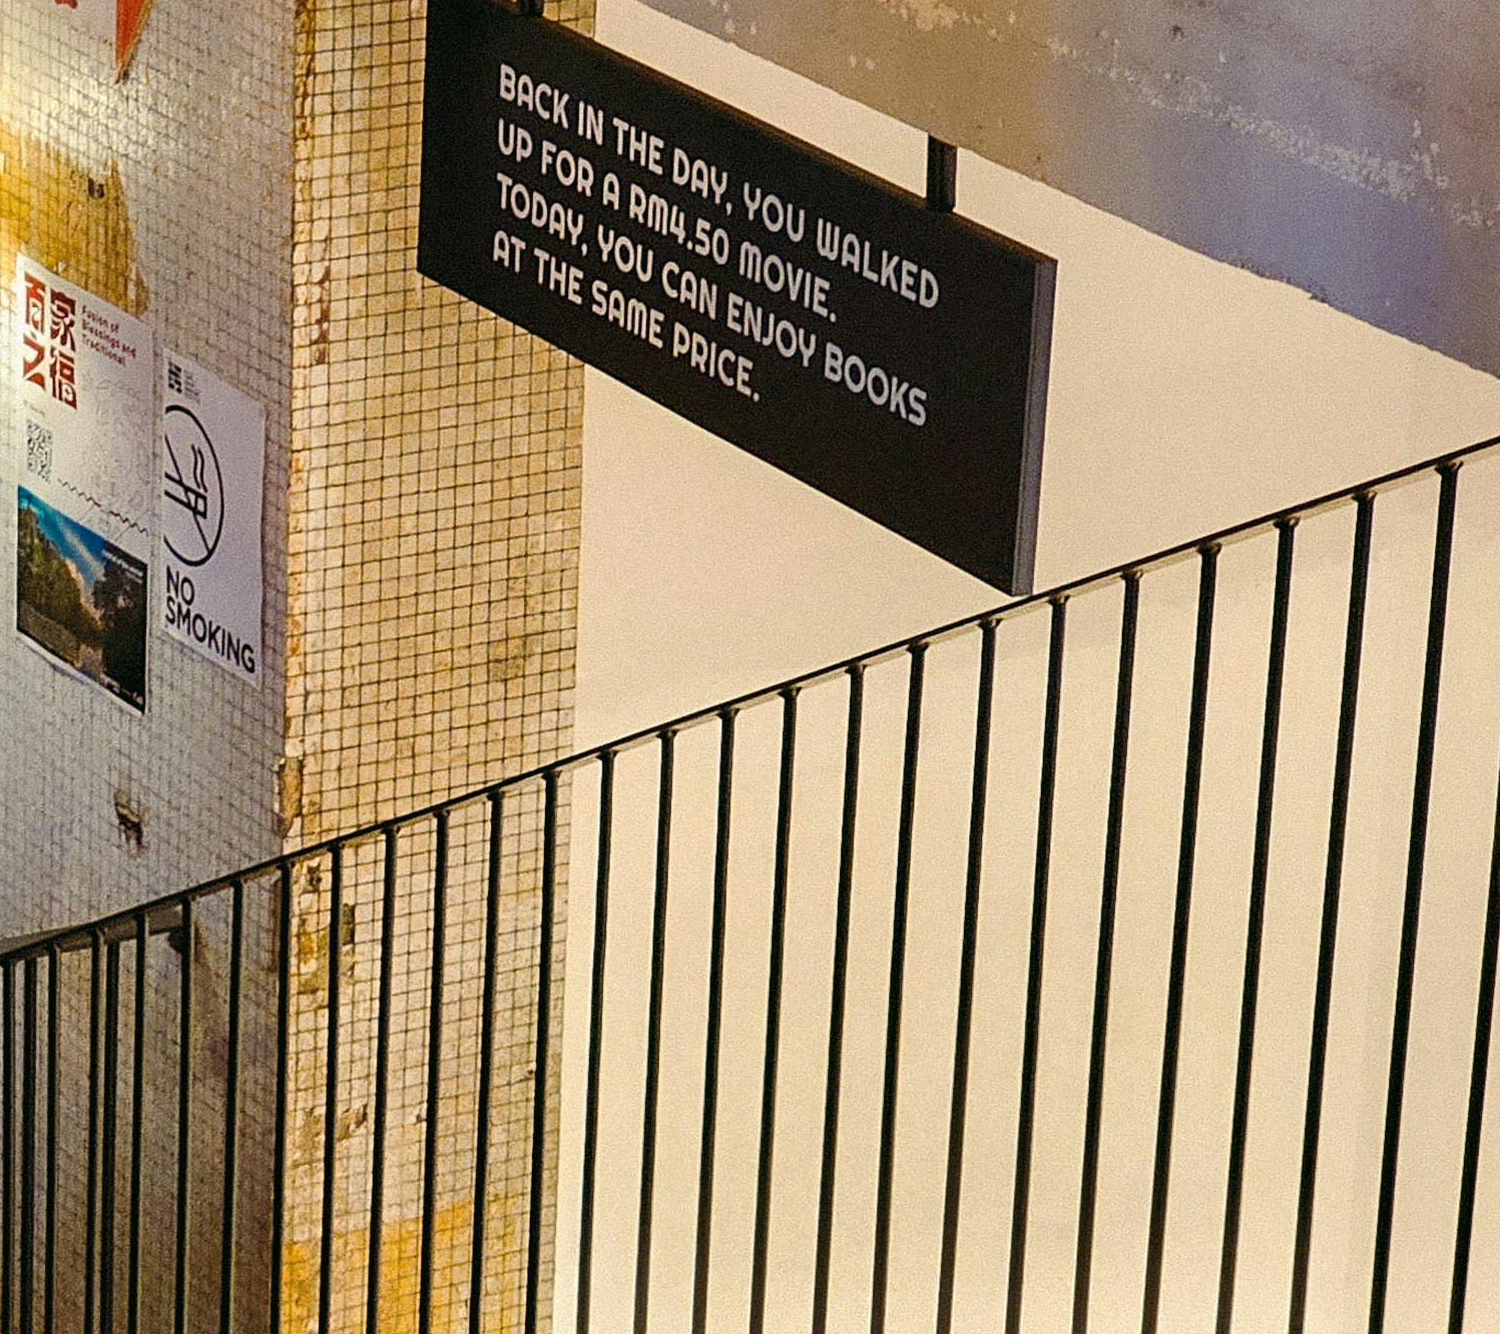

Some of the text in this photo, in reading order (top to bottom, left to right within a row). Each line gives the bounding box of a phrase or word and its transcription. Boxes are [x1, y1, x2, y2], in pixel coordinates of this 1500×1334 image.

[498, 118, 837, 323] UP FOR A RM4.50 MOVIE.
[500, 63, 940, 309] BACK IN THE DAY, YOU WALKED
[493, 230, 760, 403] AT THE SAME PRICE.
[496, 171, 928, 427] TODAY, YOU CAN ENJOY BOOKS
[165, 595, 256, 674] SMOKING
[166, 565, 195, 606] NO
